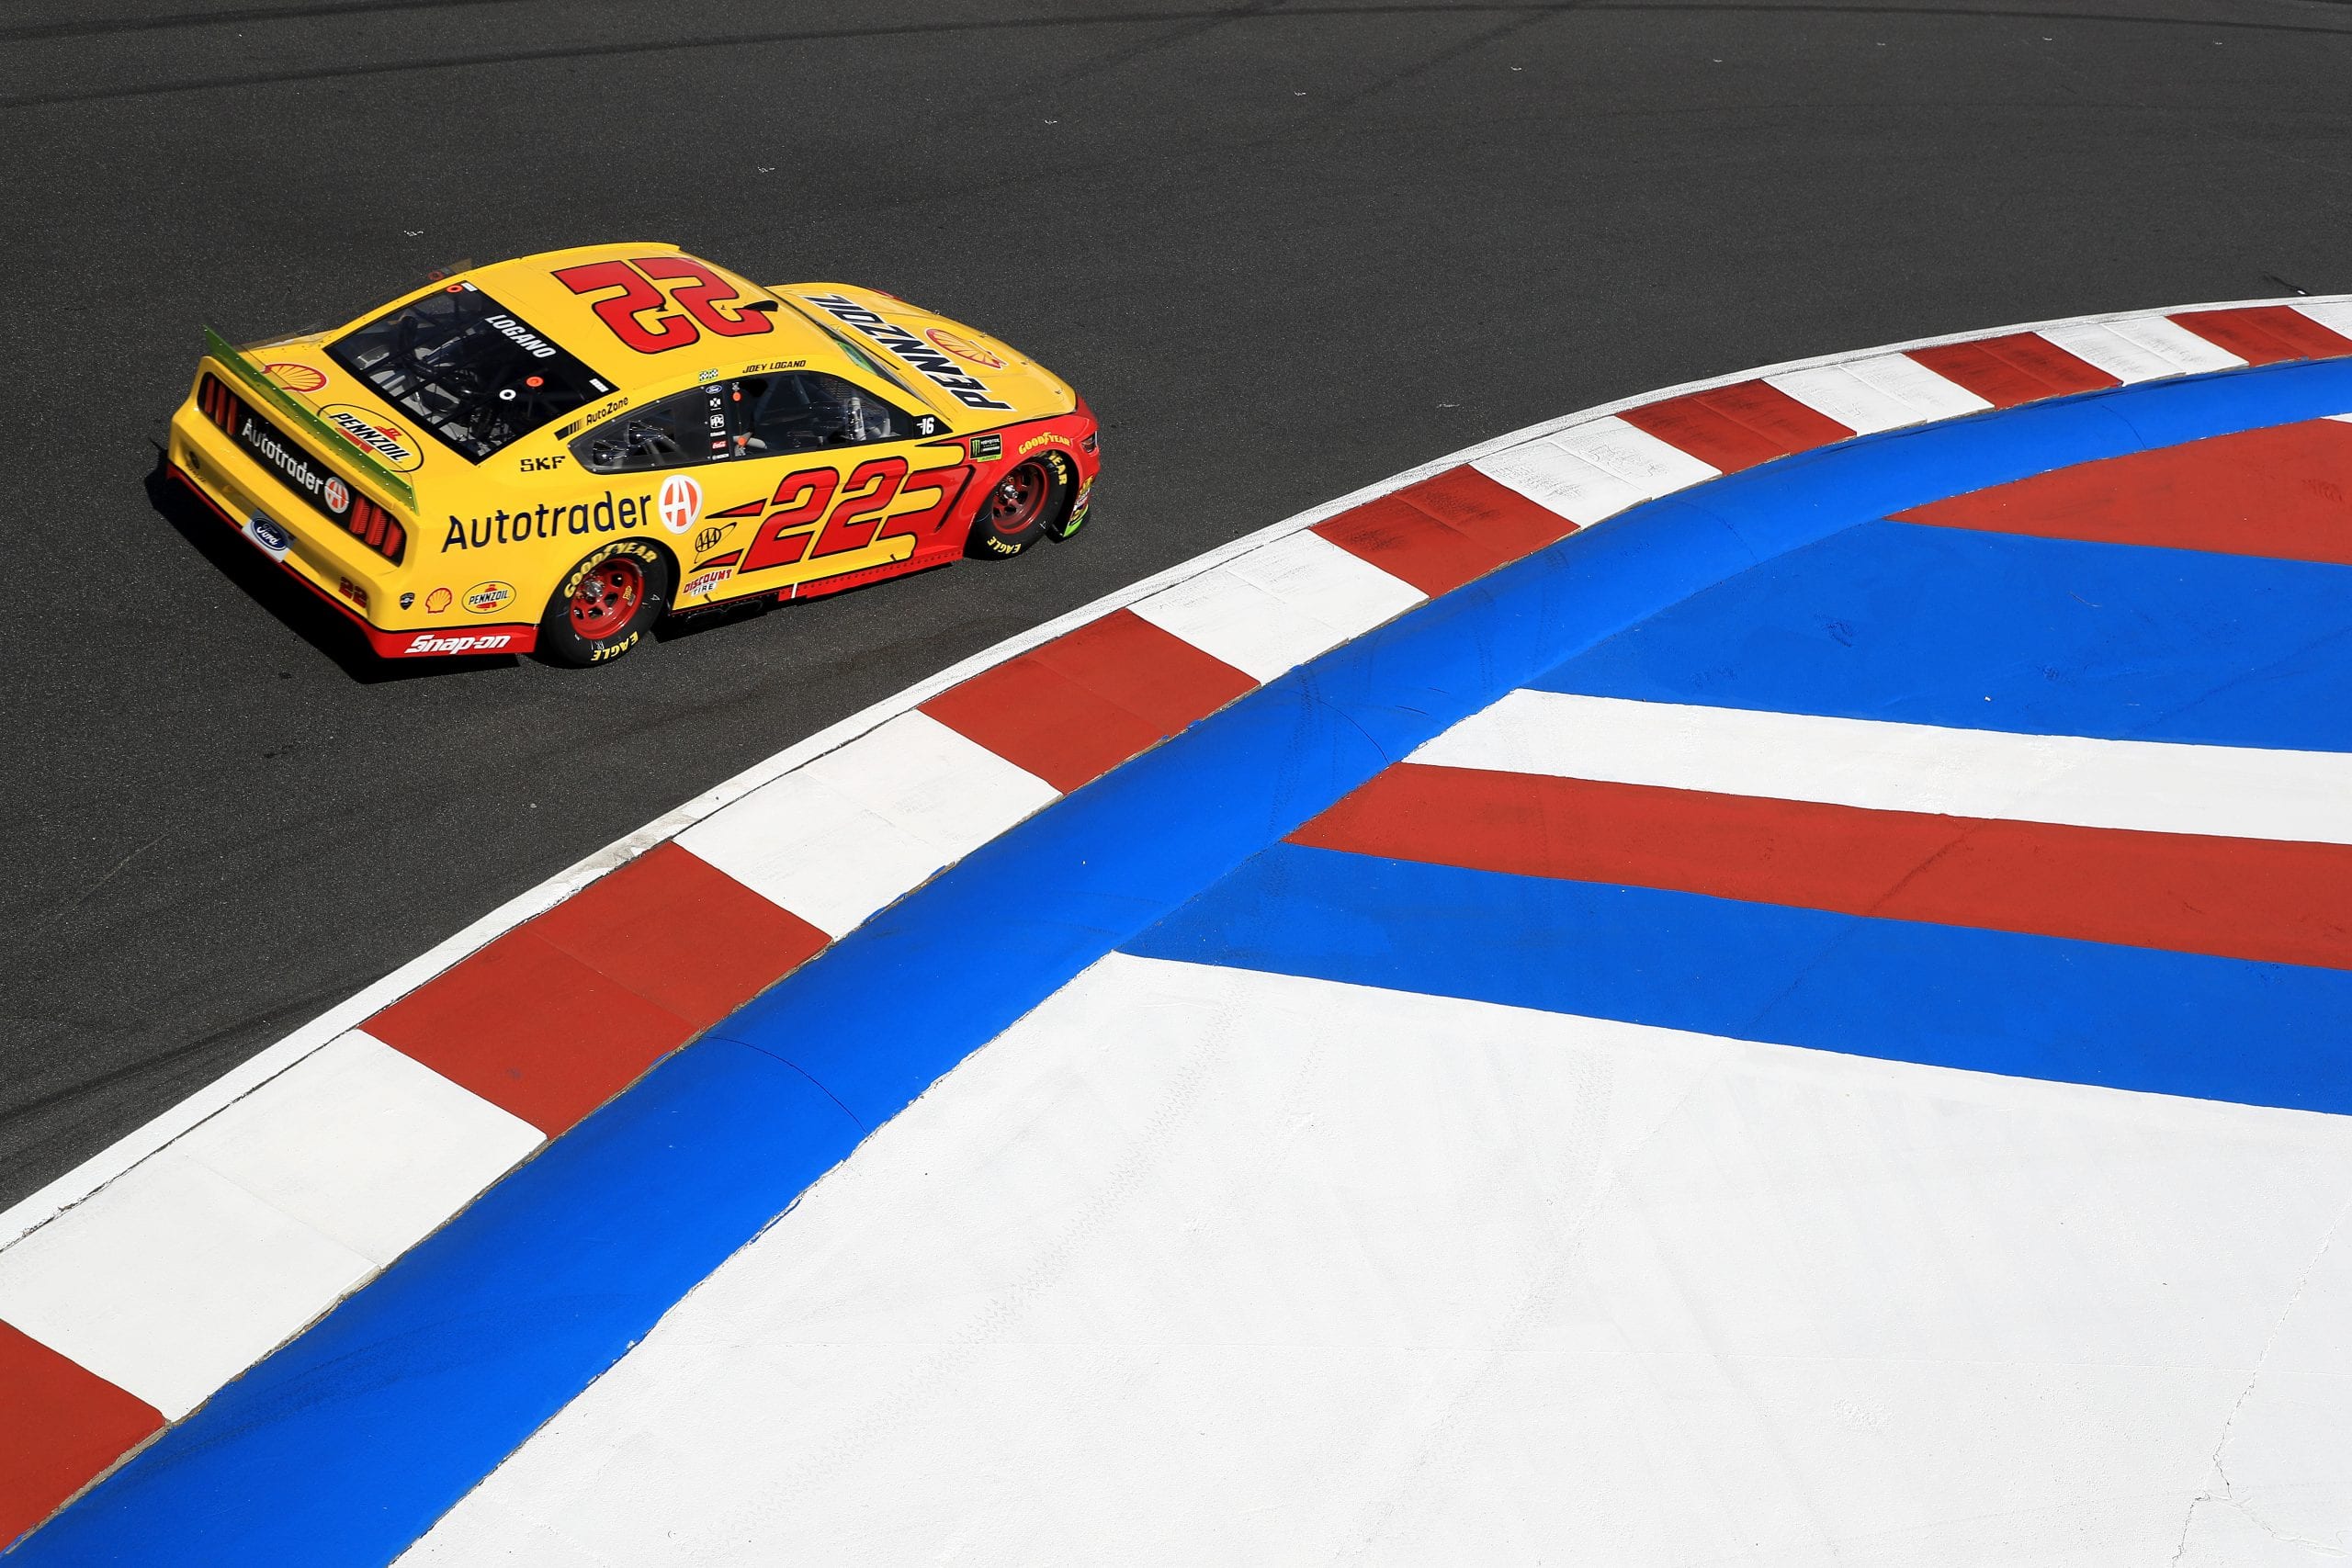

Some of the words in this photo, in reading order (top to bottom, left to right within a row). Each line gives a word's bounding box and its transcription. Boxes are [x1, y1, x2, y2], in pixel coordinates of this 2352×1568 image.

[549, 256, 775, 355] 22
[484, 314, 557, 359] LOGANO
[741, 363, 768, 374] JOEY
[769, 359, 807, 370] LOGANO
[801, 293, 1017, 412] PENNZOIL
[585, 396, 628, 426] AutoZone
[328, 412, 413, 464] PENNZOIL
[1018, 432, 1072, 456] GOODYEAR
[242, 417, 324, 495] Autotrader
[520, 456, 566, 472] SKF
[441, 491, 651, 553] Autotrader
[738, 456, 909, 574] 22
[256, 522, 281, 547] Ford
[986, 536, 1022, 554] EAGLE
[563, 542, 658, 599] GOODYEAR
[683, 569, 732, 593] DISCOUNT
[338, 576, 368, 609] 22
[468, 590, 509, 605] PENNZOIL
[693, 582, 714, 595] TIRE
[403, 634, 512, 655] Snap-on
[590, 631, 639, 661] EAGLE
